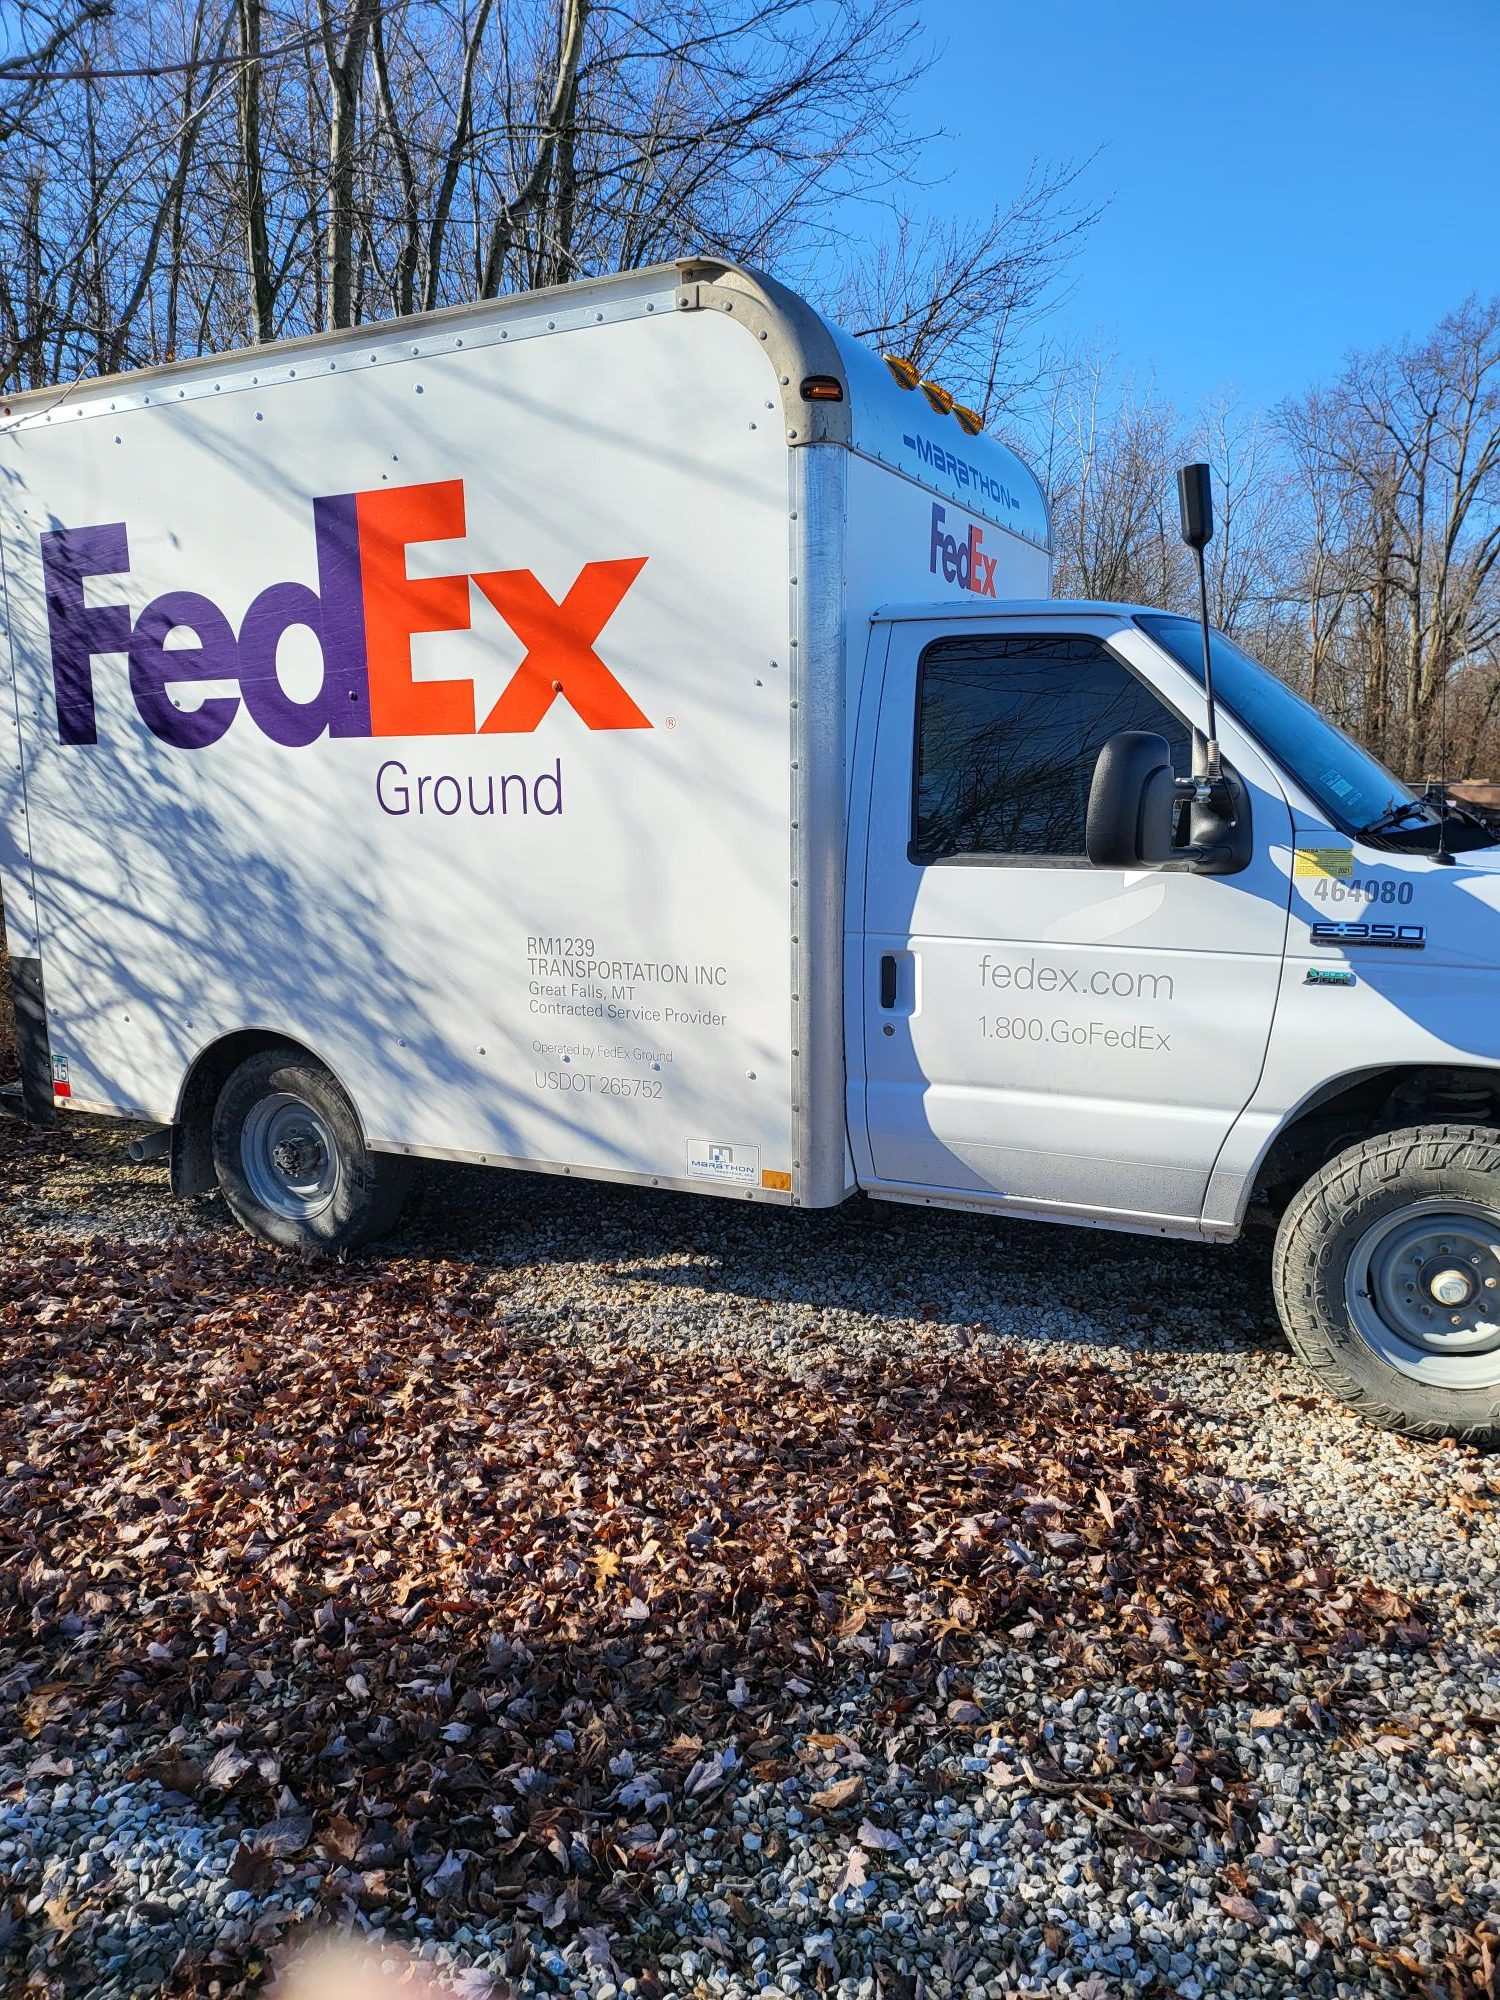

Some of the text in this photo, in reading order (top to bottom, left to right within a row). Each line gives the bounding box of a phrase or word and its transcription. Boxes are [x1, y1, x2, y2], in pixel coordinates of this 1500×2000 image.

[929, 502, 997, 599] FedEx
[40, 479, 655, 749] FedEx
[376, 758, 563, 815] Ground
[1314, 878, 1414, 905] 464080
[527, 937, 595, 957] RM1239
[527, 958, 727, 986] TRANSPORTATION INC
[978, 955, 1174, 1000] fedex.com
[529, 981, 635, 1001] Great Falls, MT
[529, 1000, 726, 1026] Contracted Service Provider
[978, 1016, 1172, 1051] 1.800.GoFedEx
[532, 1040, 673, 1062] Operated by FedEx Ground
[54, 1063, 67, 1080] 15
[535, 1070, 662, 1099] USDOT 265752
